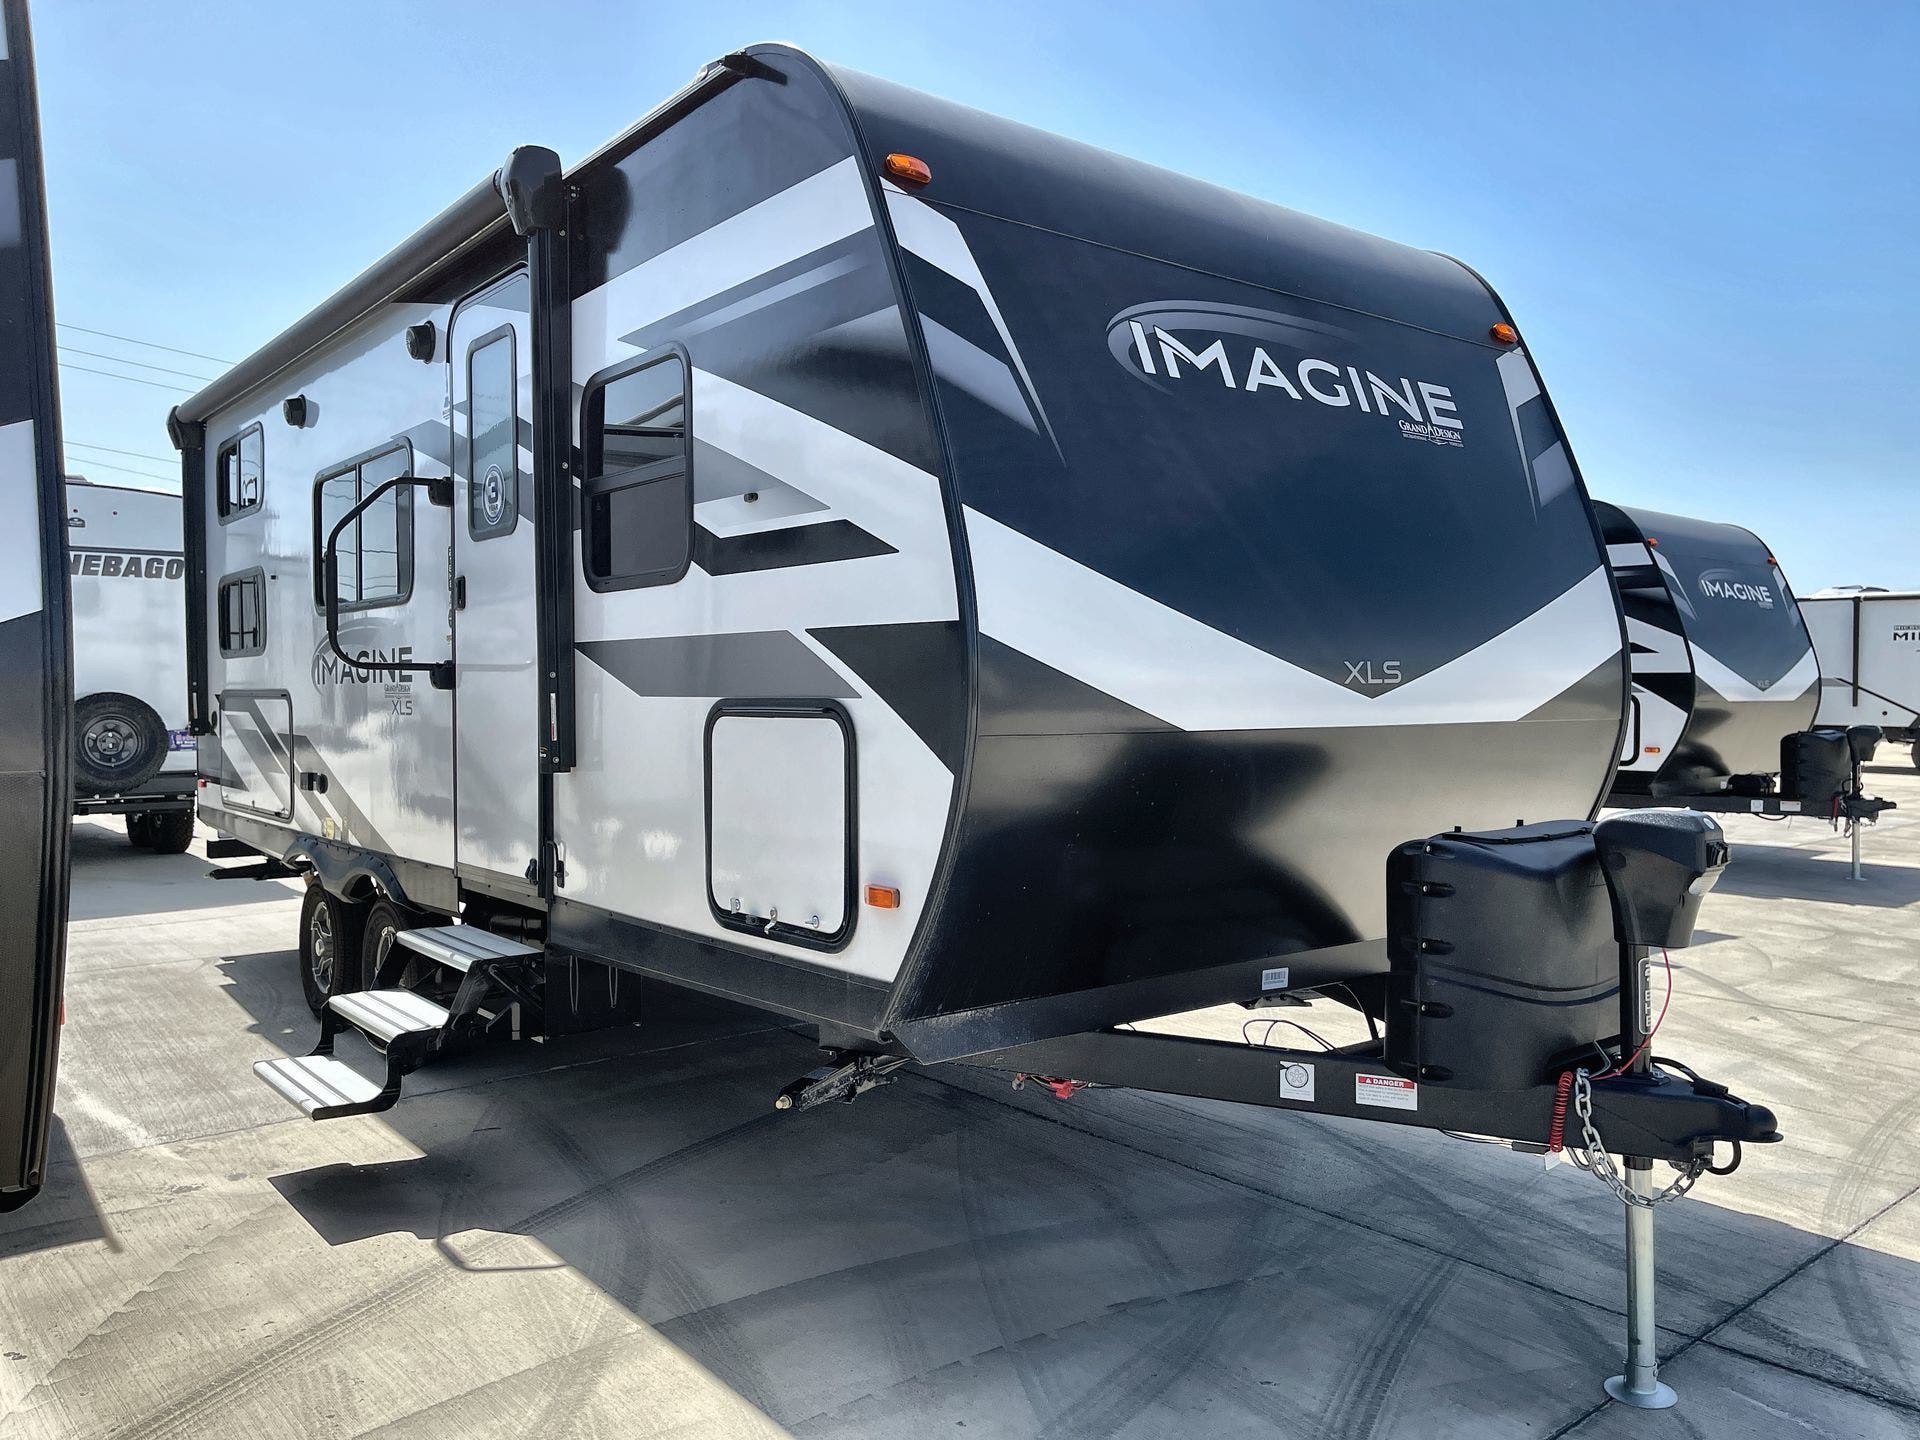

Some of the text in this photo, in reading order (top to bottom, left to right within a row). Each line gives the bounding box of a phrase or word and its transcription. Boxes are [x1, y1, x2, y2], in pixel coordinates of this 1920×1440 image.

[1129, 321, 1464, 429] IMAGINE
[1398, 419, 1428, 435] GRAND
[1432, 425, 1462, 440] DESIGN
[487, 476, 499, 504] 3
[1701, 580, 1773, 602] IMAGINE
[1893, 632, 1920, 641] MI
[316, 646, 413, 685] IMAGINE
[1343, 660, 1402, 685] XLS
[391, 700, 413, 716] XLS
[1372, 1078, 1405, 1088] DANGER
